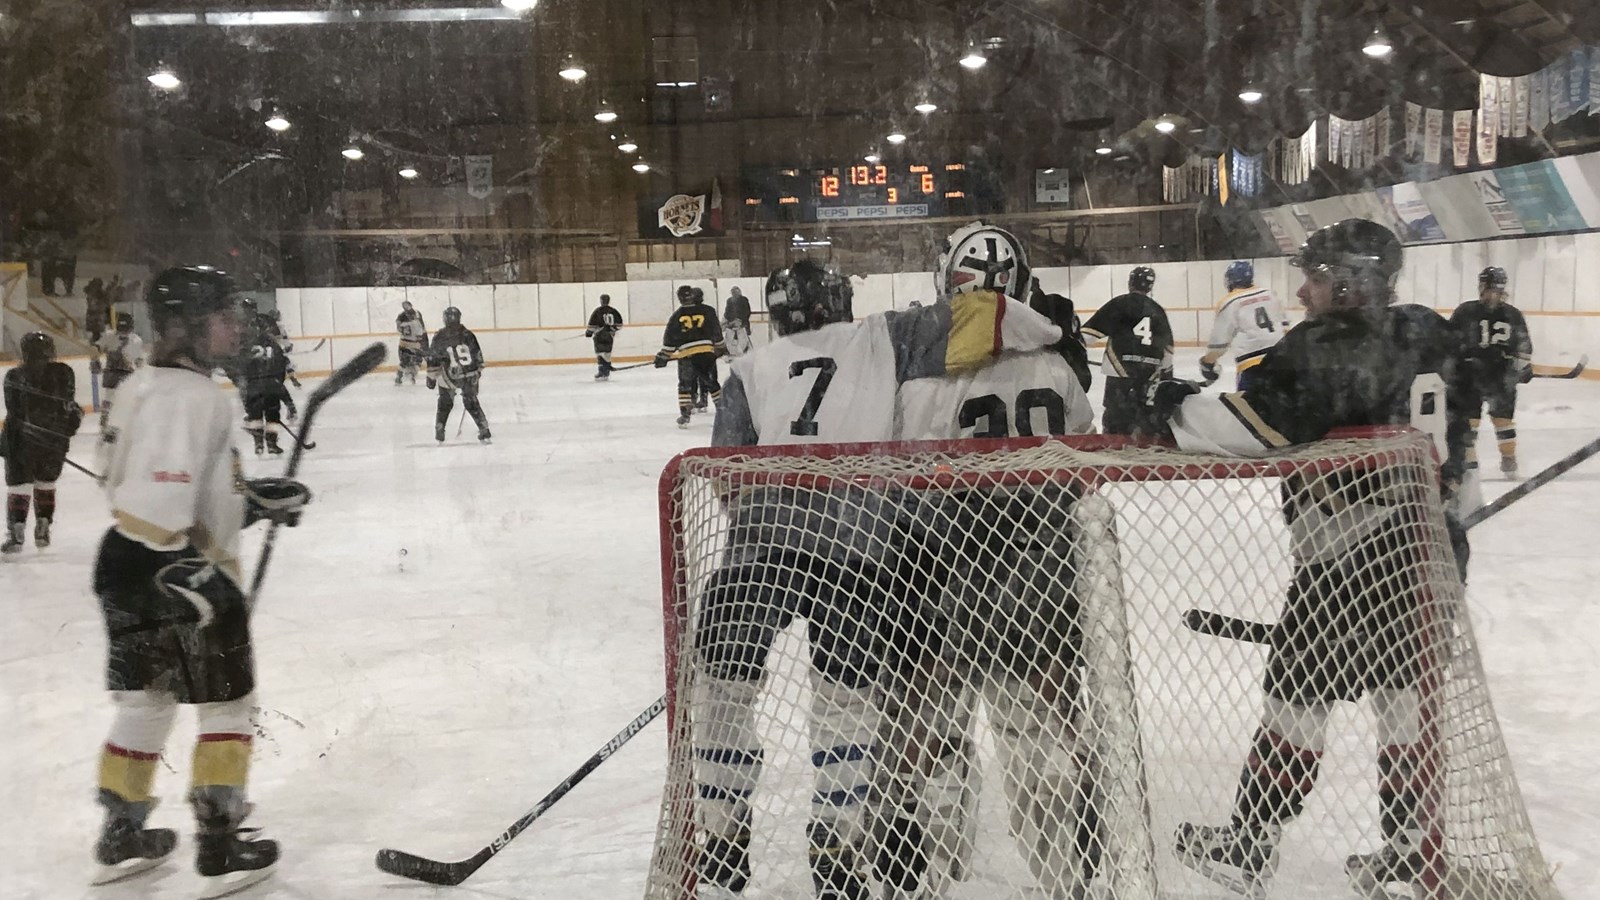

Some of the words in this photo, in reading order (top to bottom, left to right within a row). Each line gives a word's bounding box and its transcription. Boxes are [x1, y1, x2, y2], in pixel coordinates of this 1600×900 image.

[850, 165, 887, 185] 13.2
[921, 173, 934, 193] 6
[821, 176, 839, 197] 12
[887, 187, 898, 203] 3
[817, 208, 849, 217] PEPSI
[856, 207, 888, 216] PEPSI
[895, 205, 927, 216] PEPSI
[602, 313, 615, 326] 10
[679, 314, 705, 333] 37
[1254, 306, 1275, 333] 4
[1132, 316, 1153, 346] 4
[1478, 319, 1512, 349] 12
[446, 344, 472, 368] 19
[788, 356, 838, 436] 7
